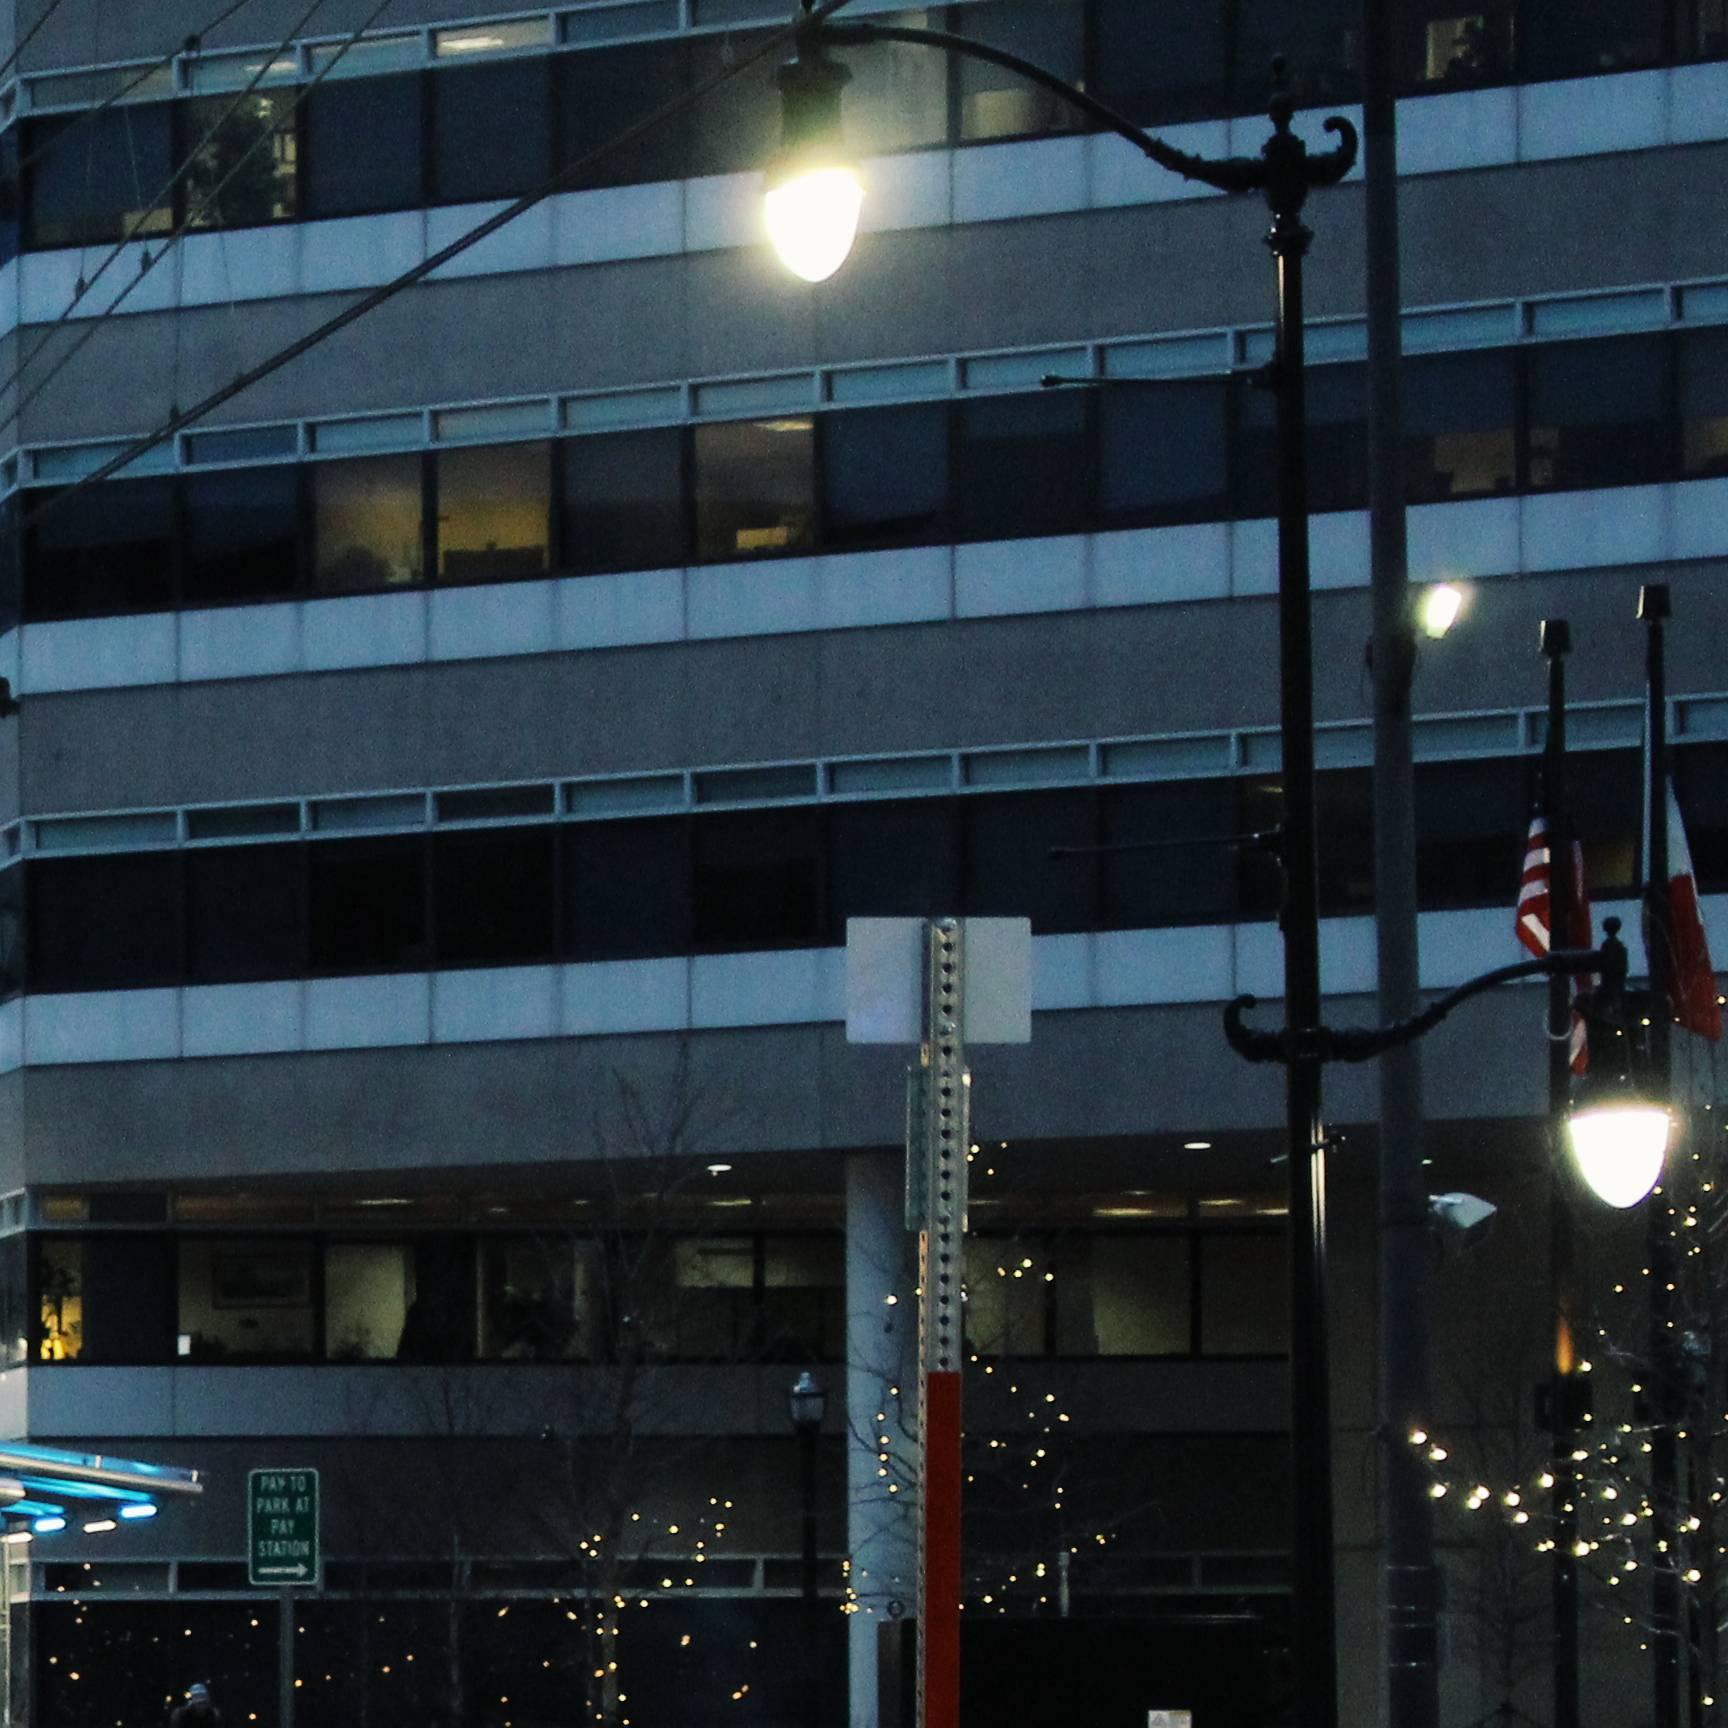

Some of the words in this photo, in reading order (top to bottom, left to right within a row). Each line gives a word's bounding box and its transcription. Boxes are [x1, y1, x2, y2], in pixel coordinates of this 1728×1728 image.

[261, 1475, 286, 1491] PAY
[290, 1475, 307, 1492] TO
[257, 1497, 290, 1513] PARK
[295, 1496, 311, 1513] AT
[271, 1519, 295, 1535] PAY
[258, 1540, 310, 1557] STATION
